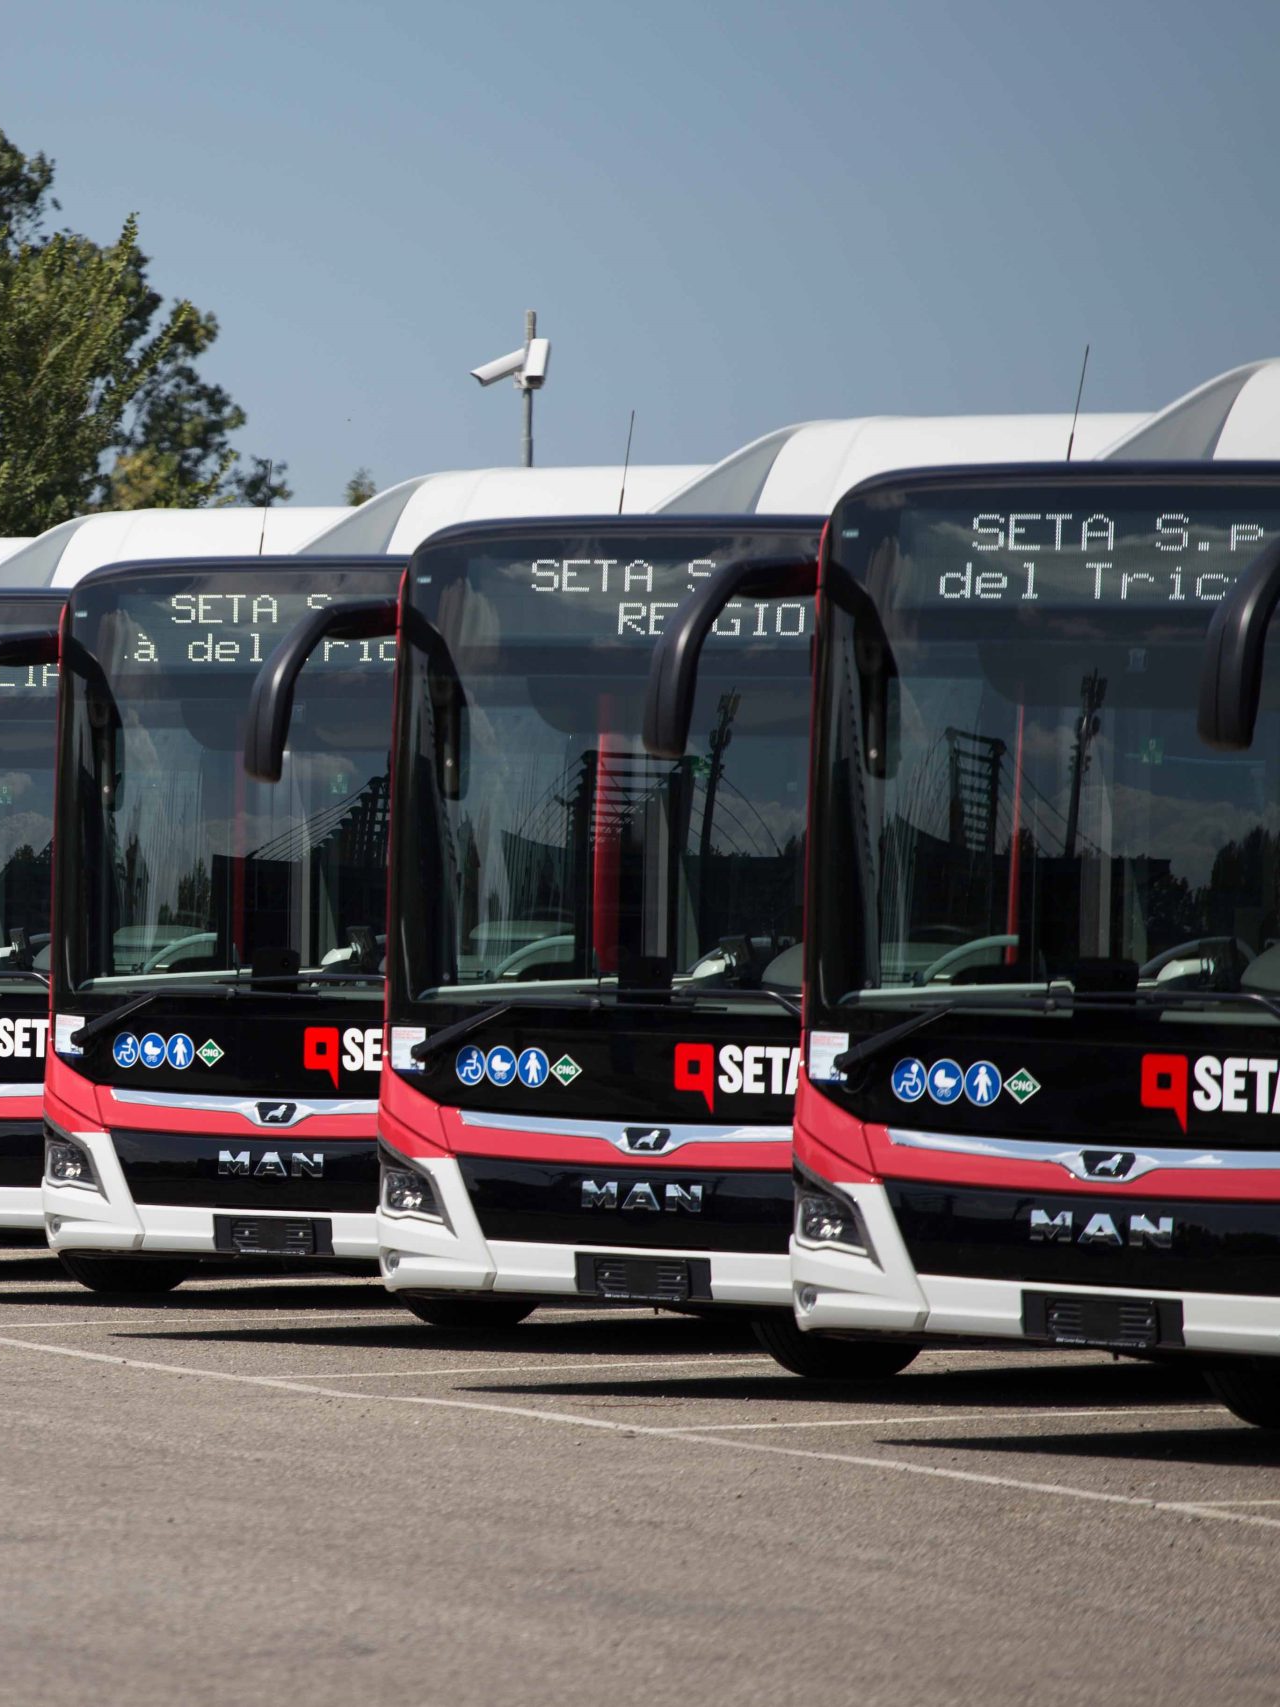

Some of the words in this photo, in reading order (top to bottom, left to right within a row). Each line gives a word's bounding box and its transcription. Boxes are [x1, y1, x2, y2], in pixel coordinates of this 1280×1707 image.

[972, 512, 1115, 552] SETA
[531, 559, 653, 593] SETA
[939, 561, 1038, 600] del
[1086, 561, 1236, 601] Tric
[171, 594, 278, 624] SETA
[188, 633, 263, 662] del
[201, 1047, 219, 1058] CNG
[555, 1064, 576, 1075] CNG
[1192, 1054, 1280, 1114] SET
[1010, 1079, 1034, 1092] CNG
[218, 1150, 324, 1178] MAN
[580, 1180, 703, 1213] MAN
[1029, 1209, 1174, 1249] MAN
